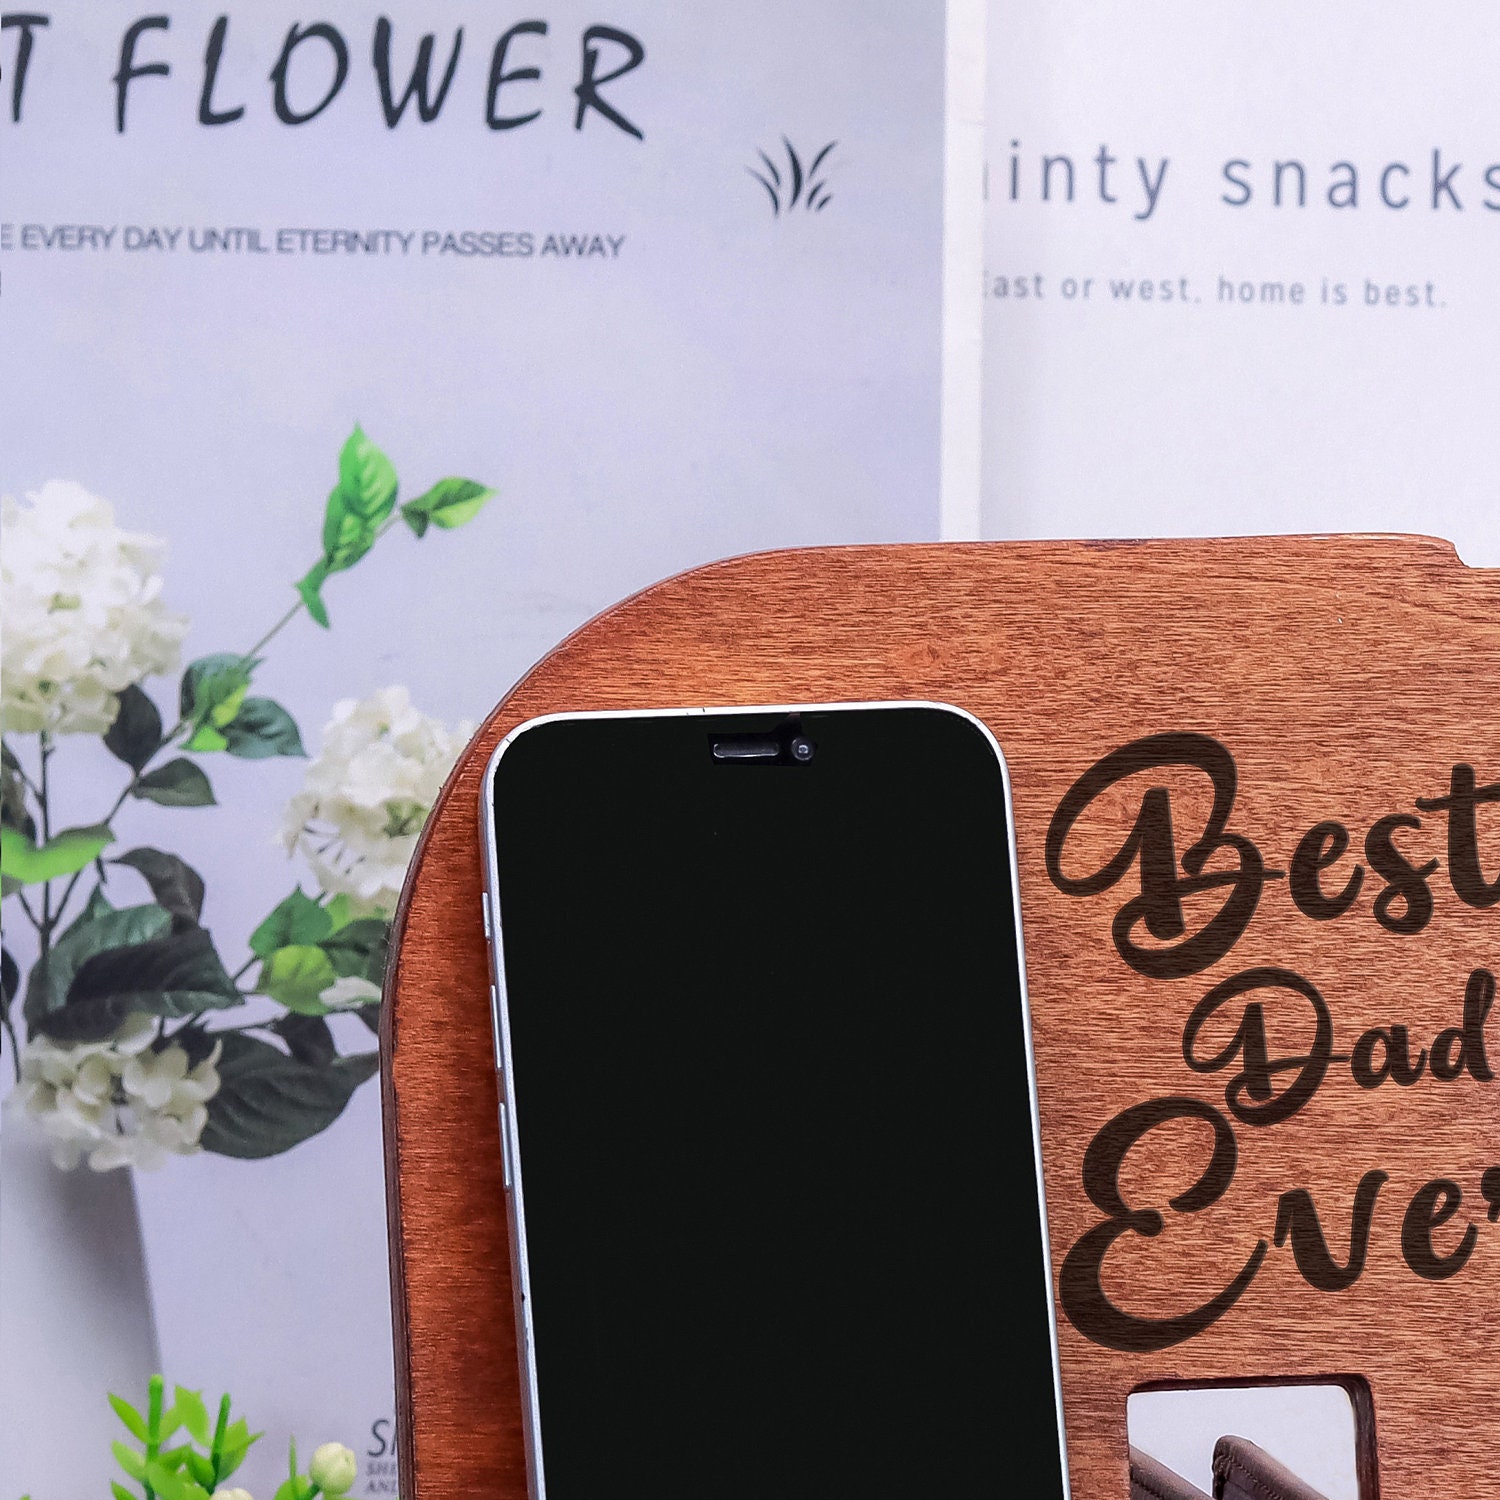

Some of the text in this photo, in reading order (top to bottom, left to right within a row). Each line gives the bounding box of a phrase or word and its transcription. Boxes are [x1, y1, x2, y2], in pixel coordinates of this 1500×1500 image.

[113, 15, 645, 141] FLOWER
[984, 138, 1169, 222] inty
[21, 224, 117, 250] EVERY
[122, 225, 182, 252] DAY
[188, 226, 269, 253] UNTIL
[275, 227, 415, 256] ETERNITY
[421, 231, 535, 258] PASSES
[540, 233, 627, 260] AWAY
[1061, 278, 1092, 299] or
[1217, 275, 1305, 305] home
[1321, 278, 1348, 305] is
[1364, 279, 1446, 307] best.
[1182, 967, 1497, 1126] Dad
